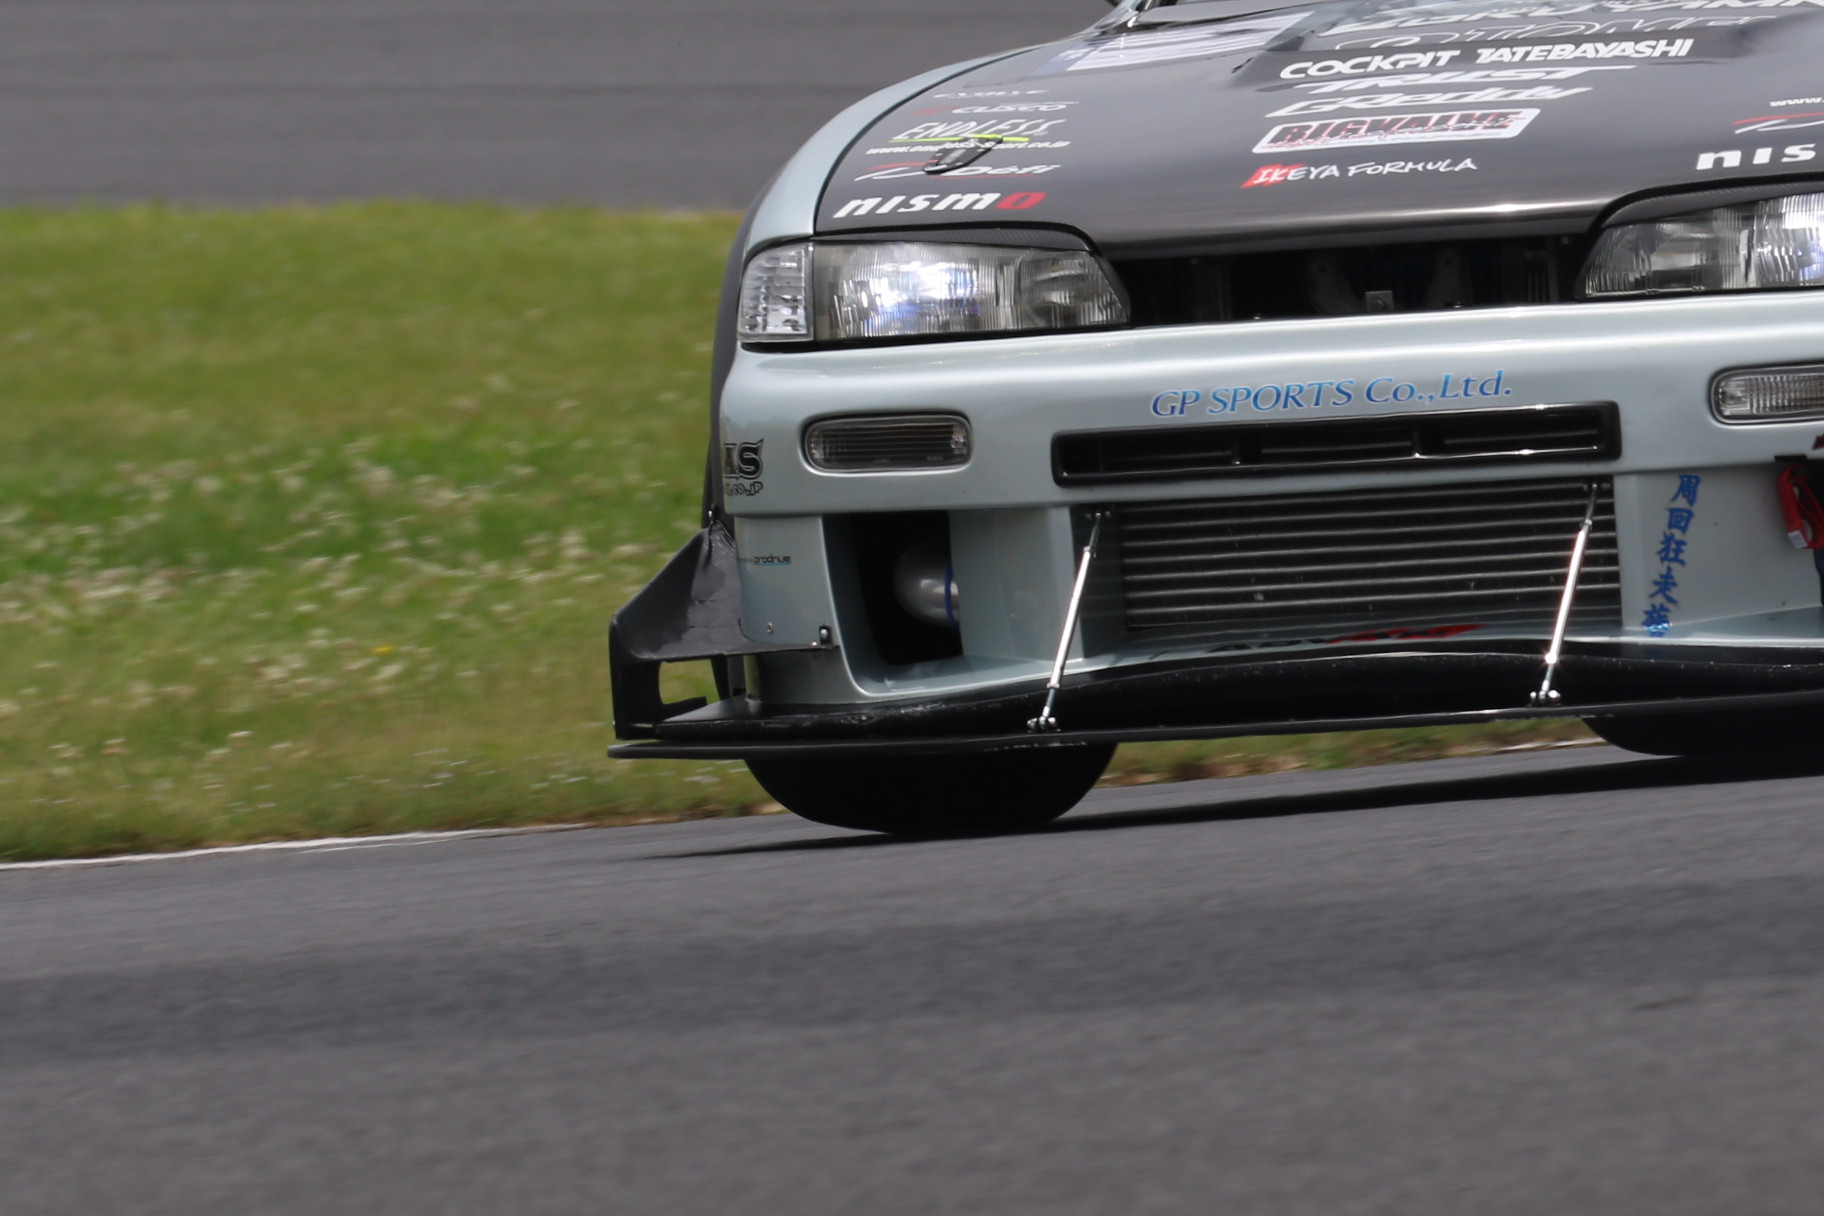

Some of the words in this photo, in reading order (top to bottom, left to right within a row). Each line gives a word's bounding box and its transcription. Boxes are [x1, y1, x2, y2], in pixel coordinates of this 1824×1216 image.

[1280, 50, 1460, 80] COCKPIT
[1476, 38, 1694, 66] TATEBAYASHI
[1293, 64, 1637, 94] TRUST
[1252, 164, 1340, 185] IKEYA
[1347, 157, 1479, 178] FORMULA
[833, 192, 1049, 219] nismo
[1151, 389, 1201, 418] GP
[1206, 379, 1356, 415] SPORTS
